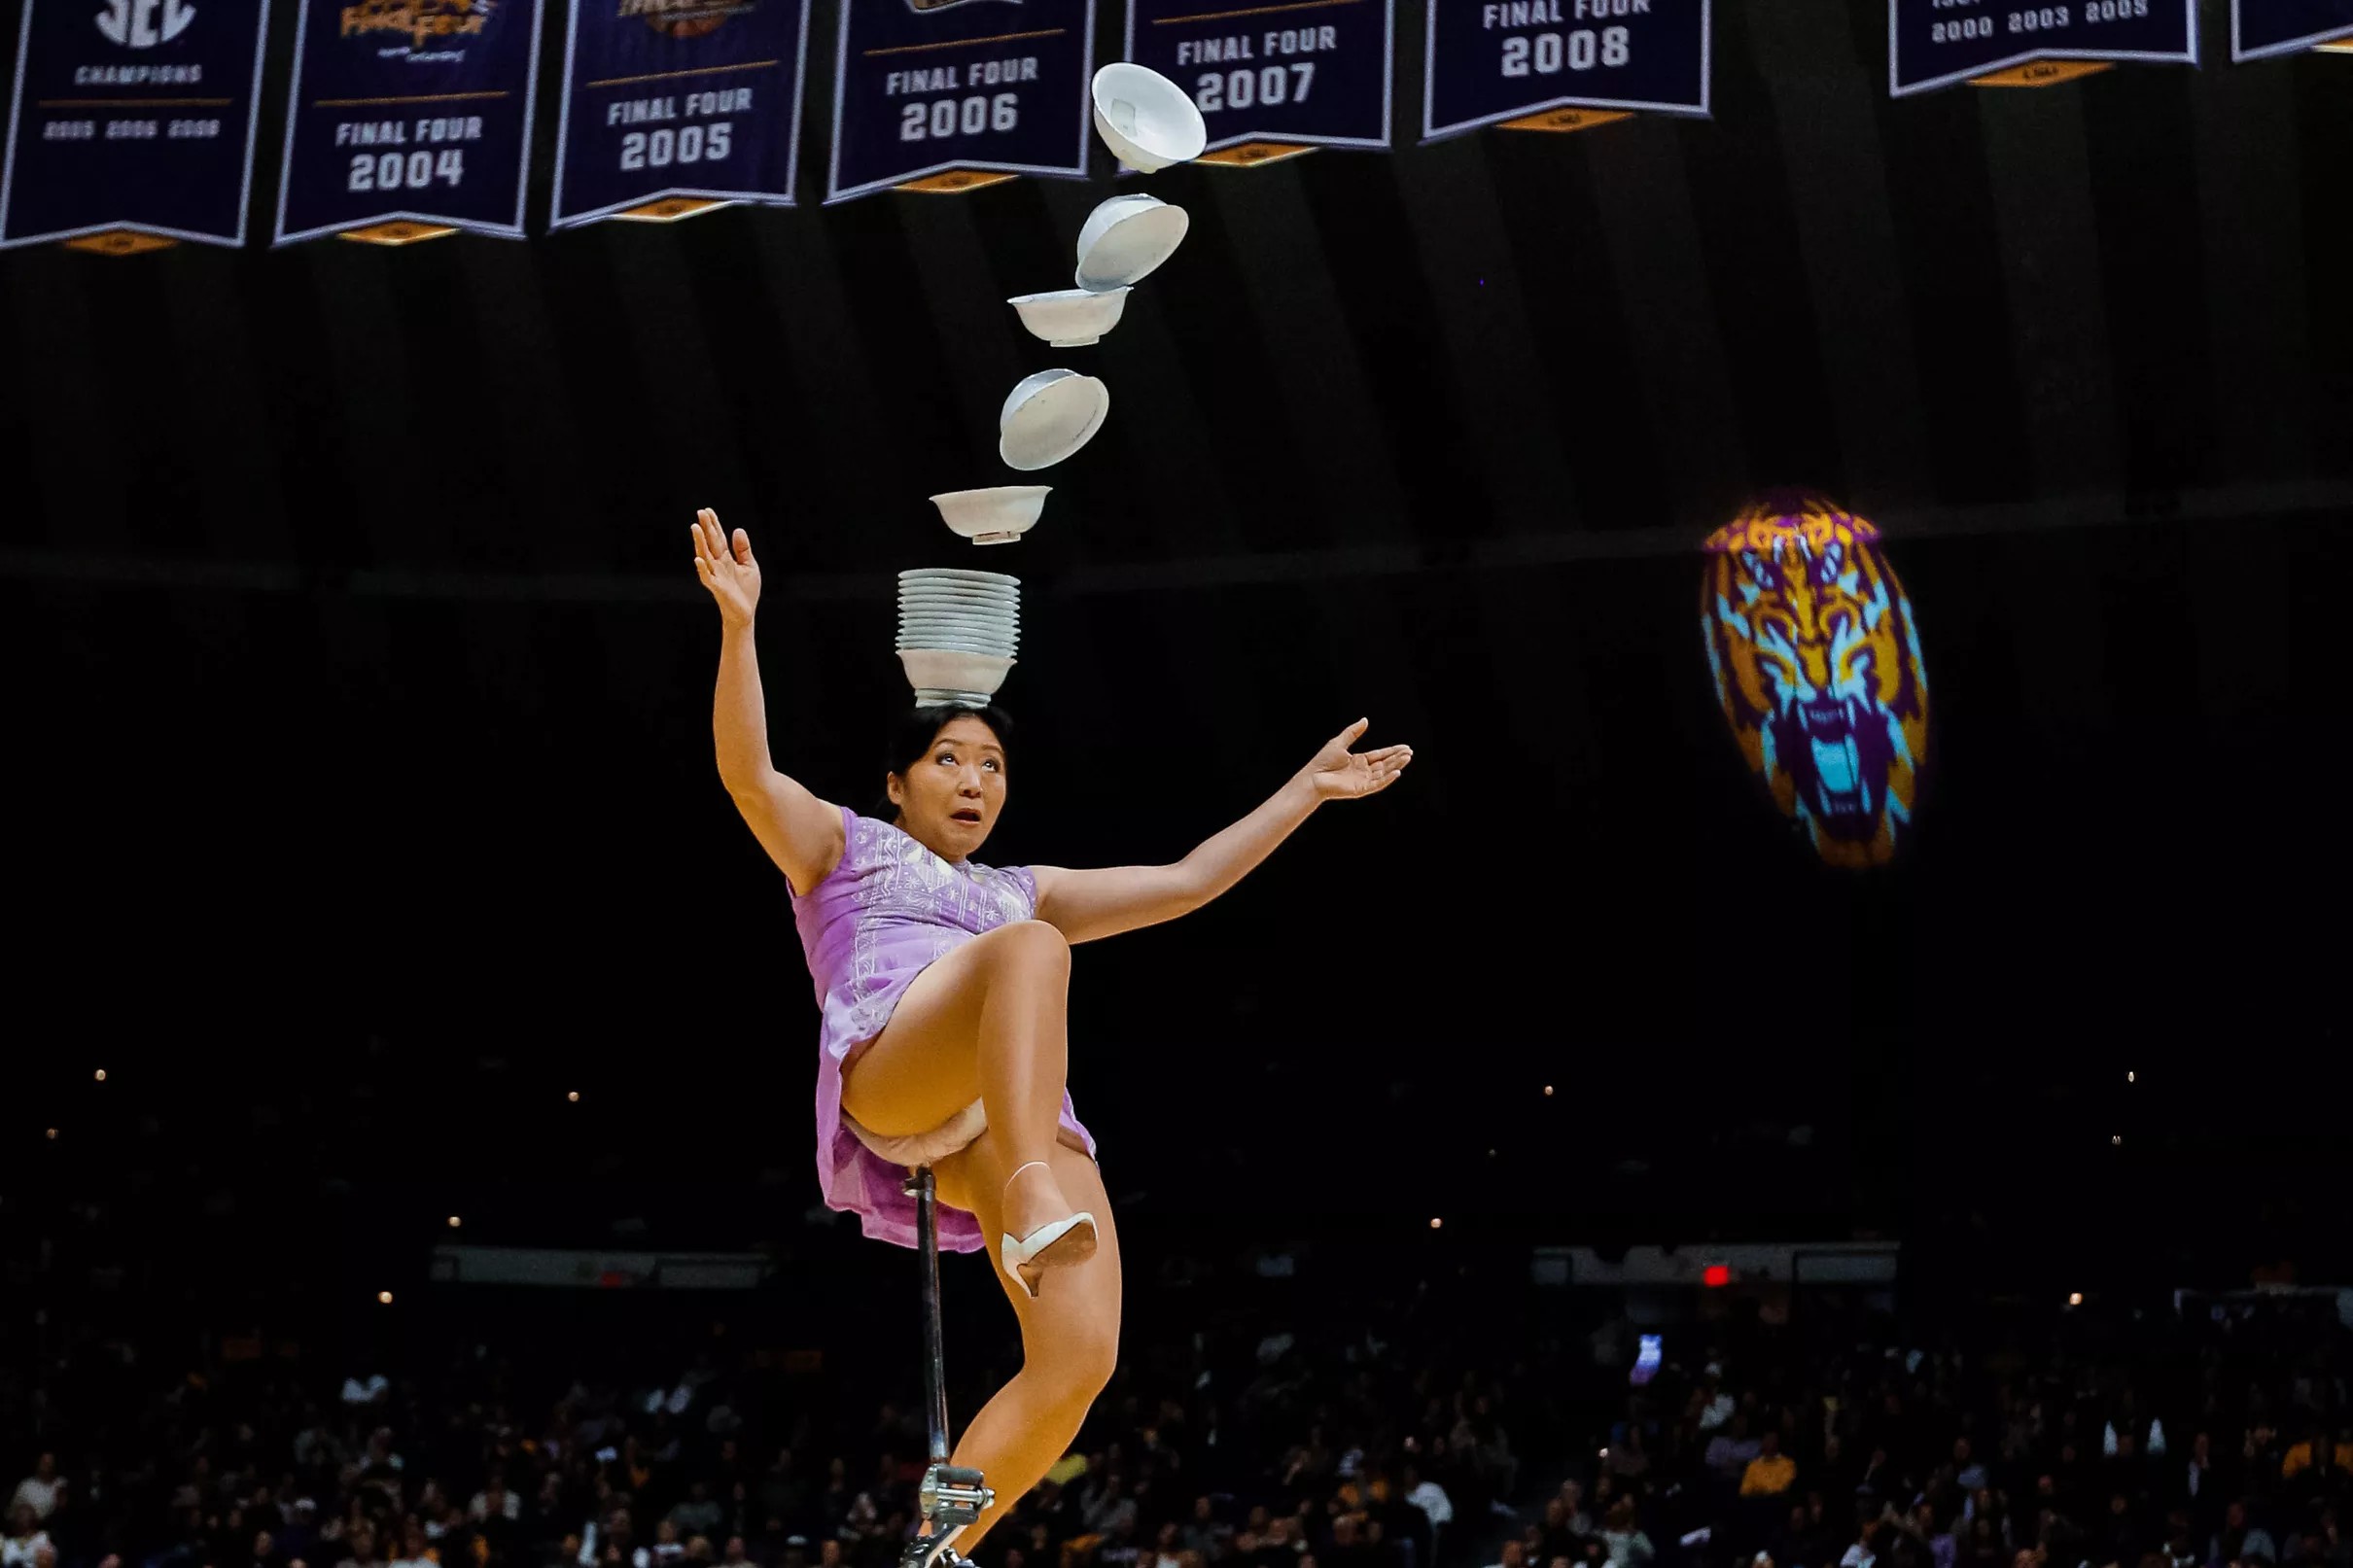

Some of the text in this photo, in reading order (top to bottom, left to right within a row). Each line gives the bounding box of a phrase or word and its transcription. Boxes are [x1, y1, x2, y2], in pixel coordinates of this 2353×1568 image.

[1483, 0, 1651, 30] FINAL FOUR
[1931, 17, 1993, 43] 2000
[1176, 25, 1337, 66] FINAL FOUR
[1500, 25, 1630, 78] 2008
[886, 56, 1038, 95] FINAL FOUR
[1196, 62, 1316, 113] 2007
[606, 87, 754, 125] FINAL FOUR
[900, 92, 1019, 142] 2006
[335, 116, 483, 147] FINAL FOUR
[619, 122, 734, 171] 2005
[348, 149, 465, 192] 2004
